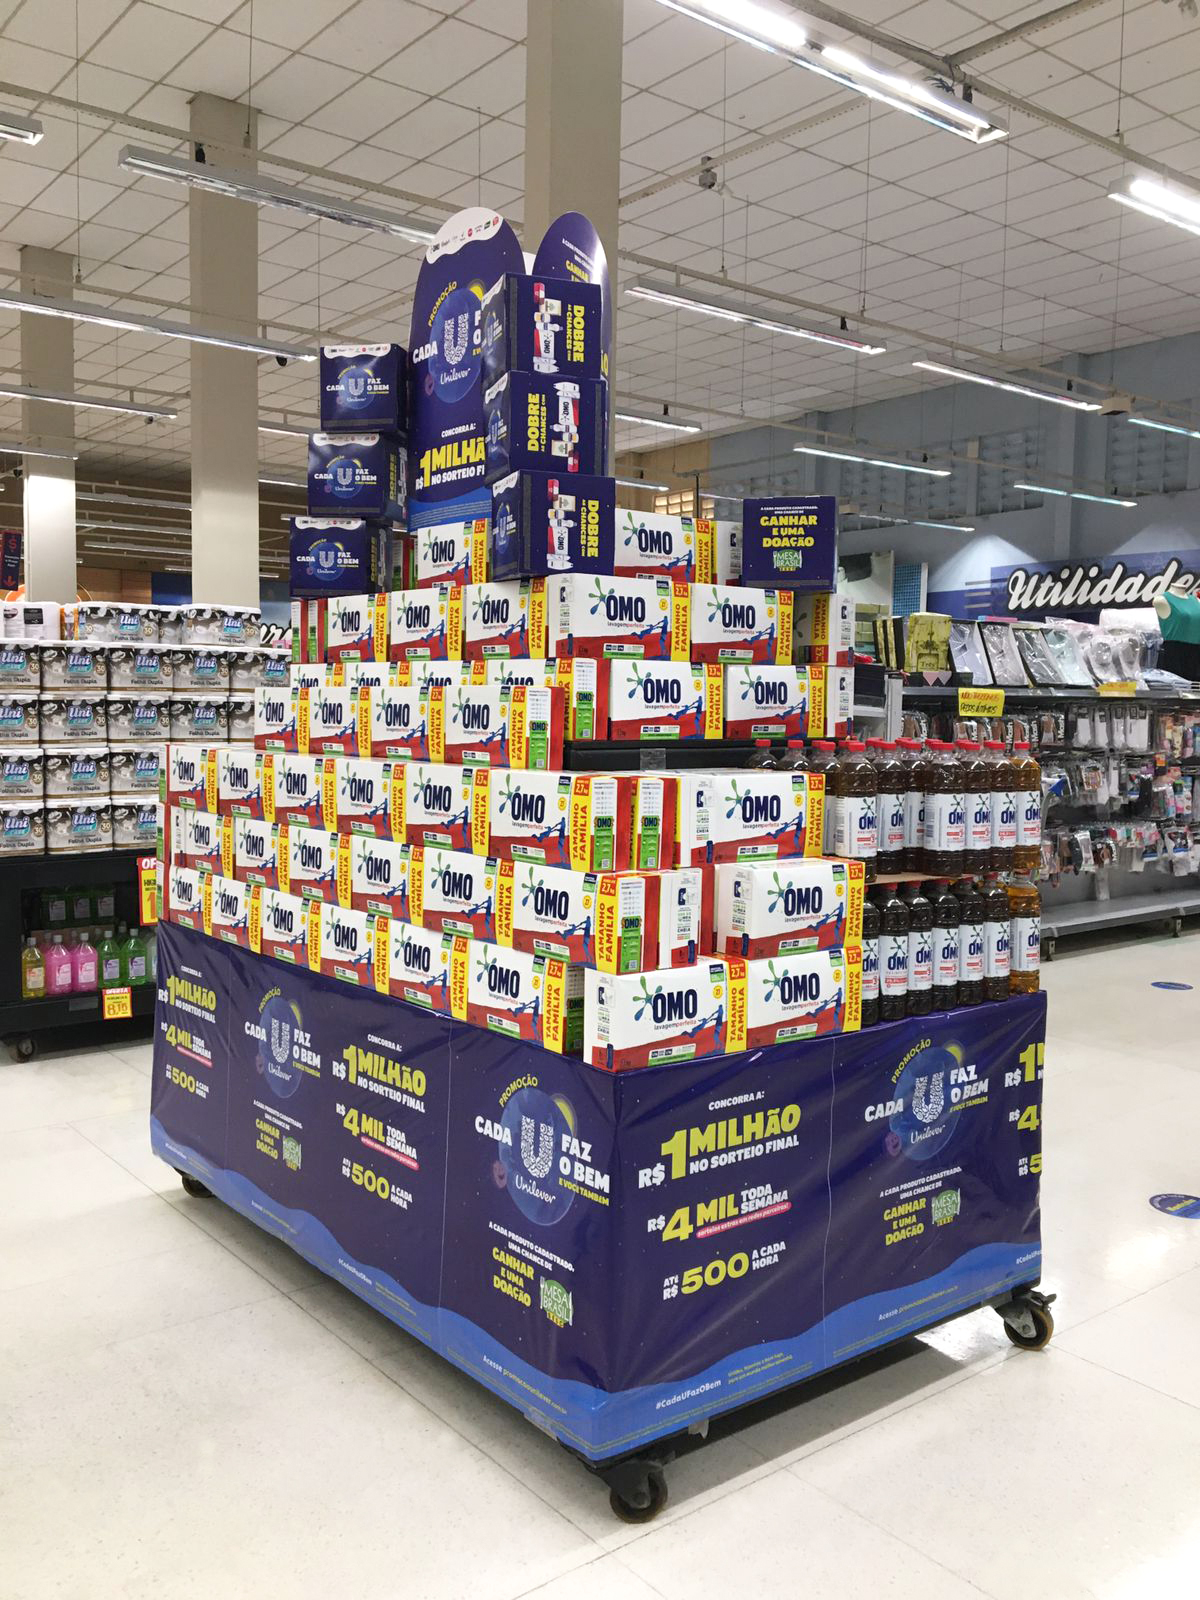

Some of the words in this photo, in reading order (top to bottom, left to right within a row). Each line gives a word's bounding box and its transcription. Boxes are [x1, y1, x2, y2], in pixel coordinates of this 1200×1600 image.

[427, 281, 458, 327] PROMOÇÃO
[573, 304, 585, 363] DOBRE
[412, 341, 438, 364] CADA
[440, 367, 471, 386] Unilever
[527, 393, 540, 452] DOBRE
[431, 436, 486, 471] MILHÃ
[442, 466, 476, 482] SORTEIO
[587, 499, 599, 558] DOBRE
[760, 515, 818, 526] GANHAR
[772, 528, 778, 536] E
[780, 527, 805, 536] UMA
[432, 540, 455, 564] OMO
[638, 529, 673, 556] OMO
[762, 536, 815, 548] DOAÇÃO
[776, 559, 800, 567] BRASIL
[777, 552, 800, 560] MESA
[605, 596, 646, 621] OMO
[642, 678, 681, 704] OMO
[754, 681, 787, 705] OMO
[265, 702, 284, 723] OMO
[462, 704, 490, 729] OMO
[286, 772, 307, 796] OMO
[350, 777, 373, 804] OMO
[511, 792, 545, 823] OMO
[741, 795, 781, 823] OMO
[572, 802, 580, 860] TAMANHO
[580, 804, 588, 862] FAMÍLIA
[442, 871, 473, 901] OMO
[220, 893, 238, 917] OMO
[504, 885, 512, 938] FAMÍLIA
[534, 888, 569, 920] OMO
[783, 886, 823, 918] OMO
[598, 902, 606, 961] TAMANHO
[606, 905, 614, 963] FAMÍLIA
[158, 988, 168, 1004] R$
[487, 967, 520, 999] OMO
[780, 973, 820, 1005] OMO
[651, 988, 698, 1024] OMO
[730, 986, 738, 1043] TAMANHO
[737, 986, 746, 1042] FAMÍLIA
[177, 1028, 192, 1050] MIL
[244, 1021, 267, 1042] CADA
[270, 1017, 290, 1064] U
[294, 1028, 311, 1048] FAZ
[367, 1034, 396, 1050] CONCORRA
[292, 1044, 300, 1060] O
[300, 1050, 321, 1070] BEM
[332, 1060, 346, 1080] R$
[890, 1038, 931, 1084] PROMOÇÃO
[171, 1066, 196, 1094] 500
[268, 1062, 292, 1081] Unilever
[950, 1064, 978, 1086] FAZ
[1004, 1068, 1022, 1088] R$
[358, 1076, 368, 1090] NO
[368, 1080, 402, 1103] SORTEIO
[402, 1094, 426, 1113] FINAL
[499, 1073, 538, 1108] PROMOÇÃO
[708, 1093, 756, 1110] CONCORRA
[912, 1071, 945, 1124] U
[950, 1087, 961, 1104] O
[962, 1078, 990, 1101] BEM
[864, 1098, 904, 1122] CADA
[1008, 1109, 1020, 1122] R$
[1016, 1104, 1040, 1131] 4
[255, 1118, 280, 1140] GANHAR
[336, 1103, 346, 1117] R$
[343, 1108, 360, 1137] 4
[361, 1113, 386, 1144] MIL
[386, 1124, 406, 1144] TODA
[474, 1116, 512, 1146] CADA
[910, 1124, 946, 1144] Unilever
[386, 1135, 418, 1160] SEMANA
[520, 1115, 554, 1178] U
[561, 1133, 592, 1162] FAZ
[689, 1158, 709, 1175] NO
[710, 1143, 764, 1169] SORTEIO
[765, 1134, 800, 1154] FINAL
[351, 1162, 390, 1200] 500
[559, 1156, 571, 1176] O
[573, 1160, 610, 1194] BEM
[638, 1162, 666, 1189] R$
[900, 1177, 926, 1193] PRODUTO
[390, 1193, 408, 1210] HORA
[396, 1186, 413, 1203] CADA
[515, 1174, 556, 1204] Unilever
[740, 1184, 773, 1202] TODA
[740, 1190, 789, 1214] SEMANA
[913, 1184, 934, 1196] CHANCE
[935, 1194, 958, 1208] MESA
[647, 1214, 666, 1232] R$
[662, 1206, 694, 1242] 4
[696, 1194, 740, 1227] MIL
[883, 1198, 926, 1221] GANHAR
[892, 1220, 898, 1230] E
[899, 1215, 917, 1228] UMA
[934, 1204, 959, 1220] BRASIL
[493, 1224, 508, 1237] CADA
[508, 1230, 534, 1250] PRODUTO
[697, 1224, 721, 1236] sorteios
[721, 1218, 740, 1230] extras
[748, 1212, 762, 1222] redes
[885, 1222, 925, 1246] DOAÇÃO
[492, 1246, 534, 1280] GANHAR
[508, 1241, 521, 1254] UMA
[522, 1248, 544, 1267] CHANCE
[752, 1250, 759, 1260] A
[760, 1241, 786, 1257] CADA
[752, 1254, 779, 1270] HORA
[500, 1266, 506, 1277] E
[506, 1270, 524, 1288] UMA
[663, 1284, 678, 1300] R$
[680, 1252, 750, 1295] 500
[493, 1274, 532, 1308] DOAÇÃO
[544, 1284, 570, 1309] MESA
[543, 1296, 570, 1322] BRASIL
[656, 1380, 722, 1410] #CadaUFazOBem
